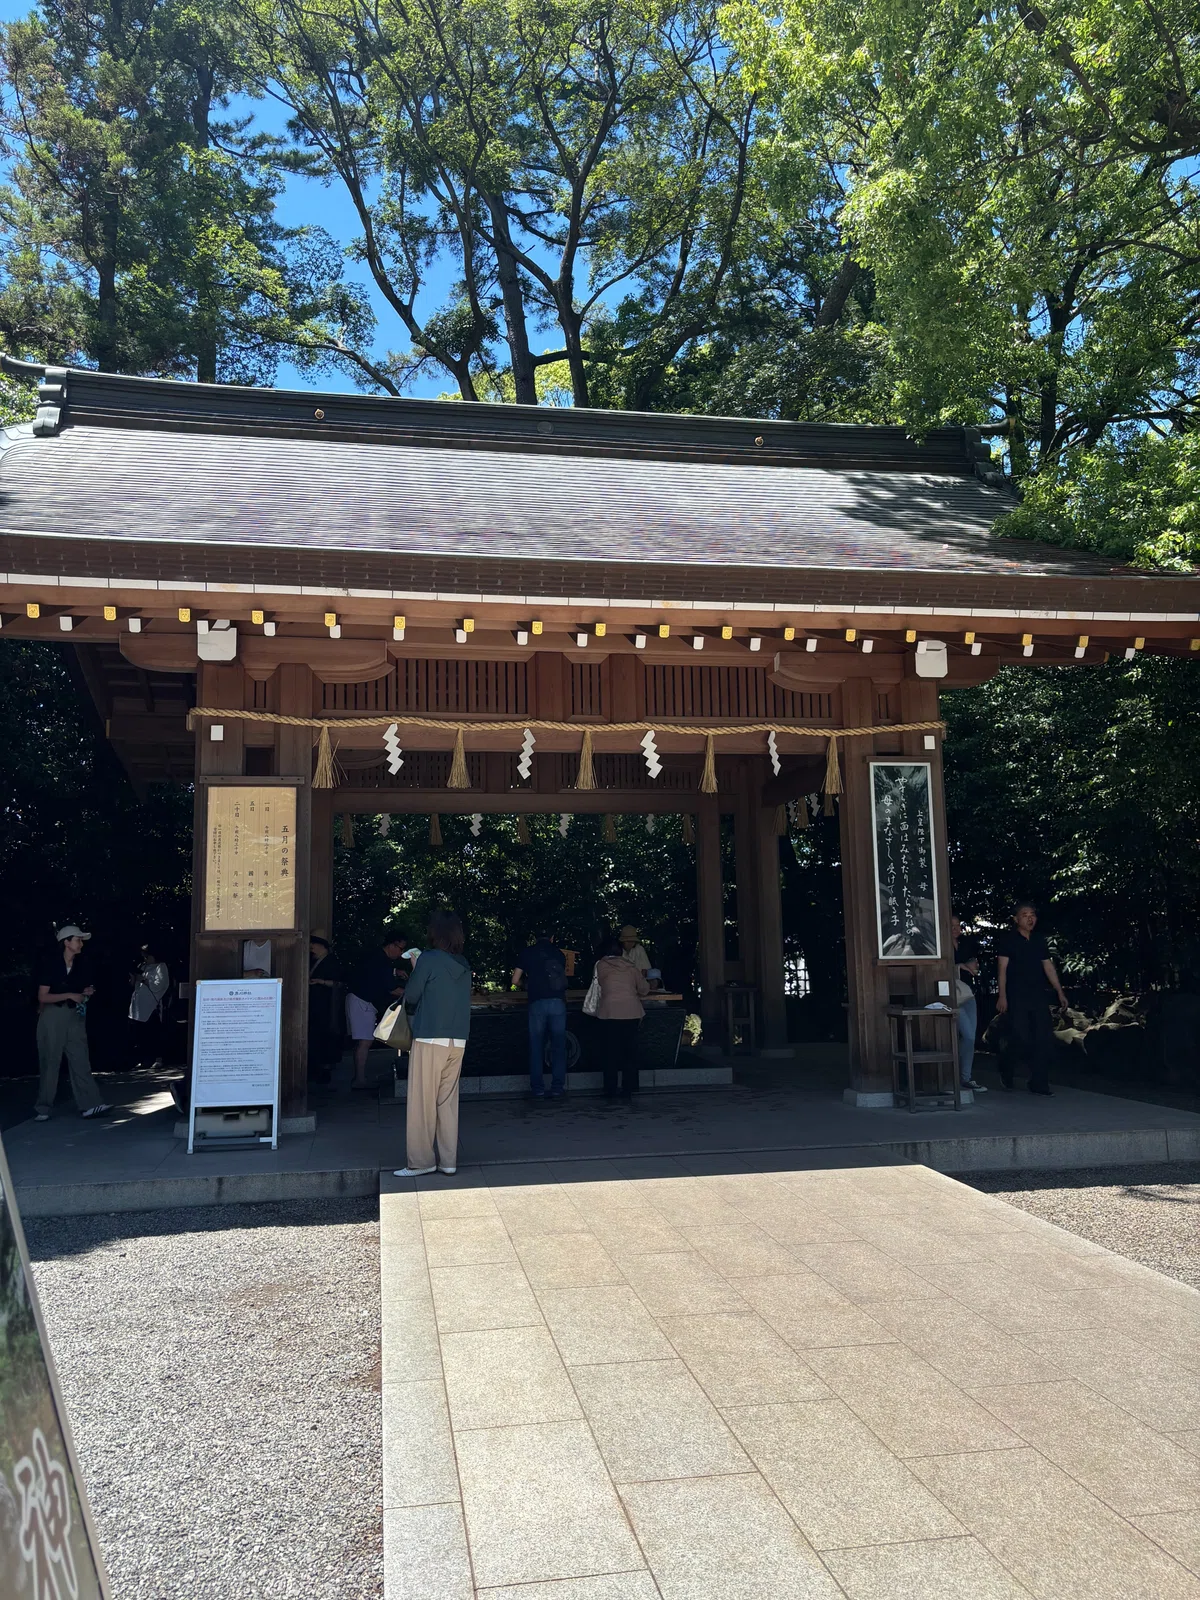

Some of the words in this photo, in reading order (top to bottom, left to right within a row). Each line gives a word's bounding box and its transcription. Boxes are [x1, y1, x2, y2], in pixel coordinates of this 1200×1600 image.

[249, 801, 256, 812] 五日
[264, 801, 270, 812] 一日
[280, 825, 289, 877] 五月の祭典
[916, 810, 928, 869] 上皇陛下御製
